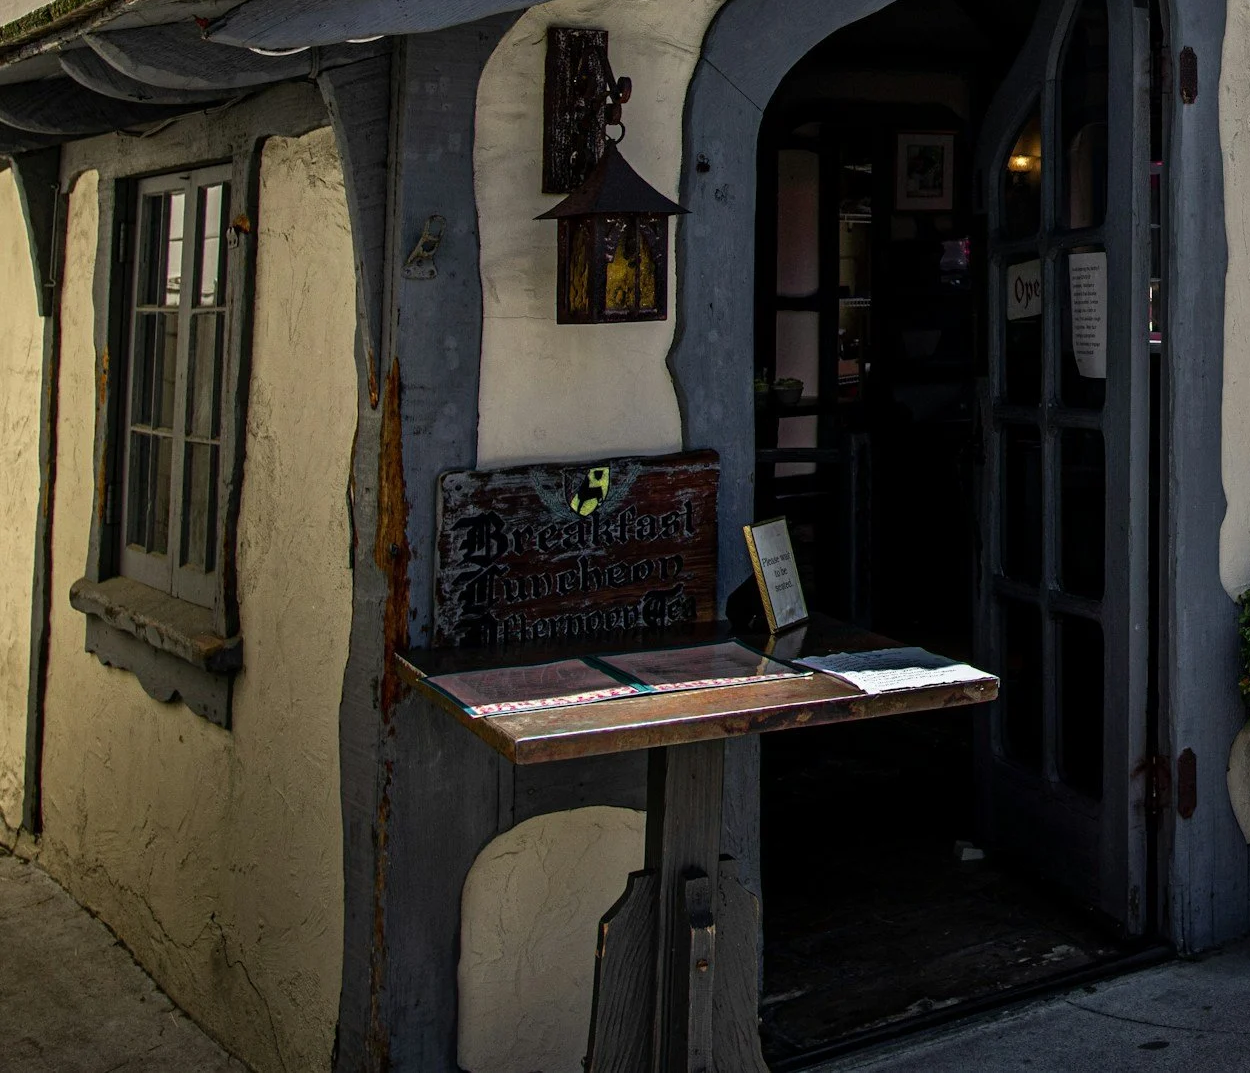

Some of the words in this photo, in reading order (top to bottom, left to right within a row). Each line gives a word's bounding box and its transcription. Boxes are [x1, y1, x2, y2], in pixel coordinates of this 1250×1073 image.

[1014, 275, 1042, 310] Ope
[450, 499, 698, 568] Breakfast
[762, 556, 780, 568] Please
[779, 551, 791, 561] wait
[774, 570, 781, 578] to
[780, 566, 788, 576] be
[451, 553, 685, 615] Luncheon
[451, 601, 643, 647] Afternoon
[641, 582, 698, 629] Tea
